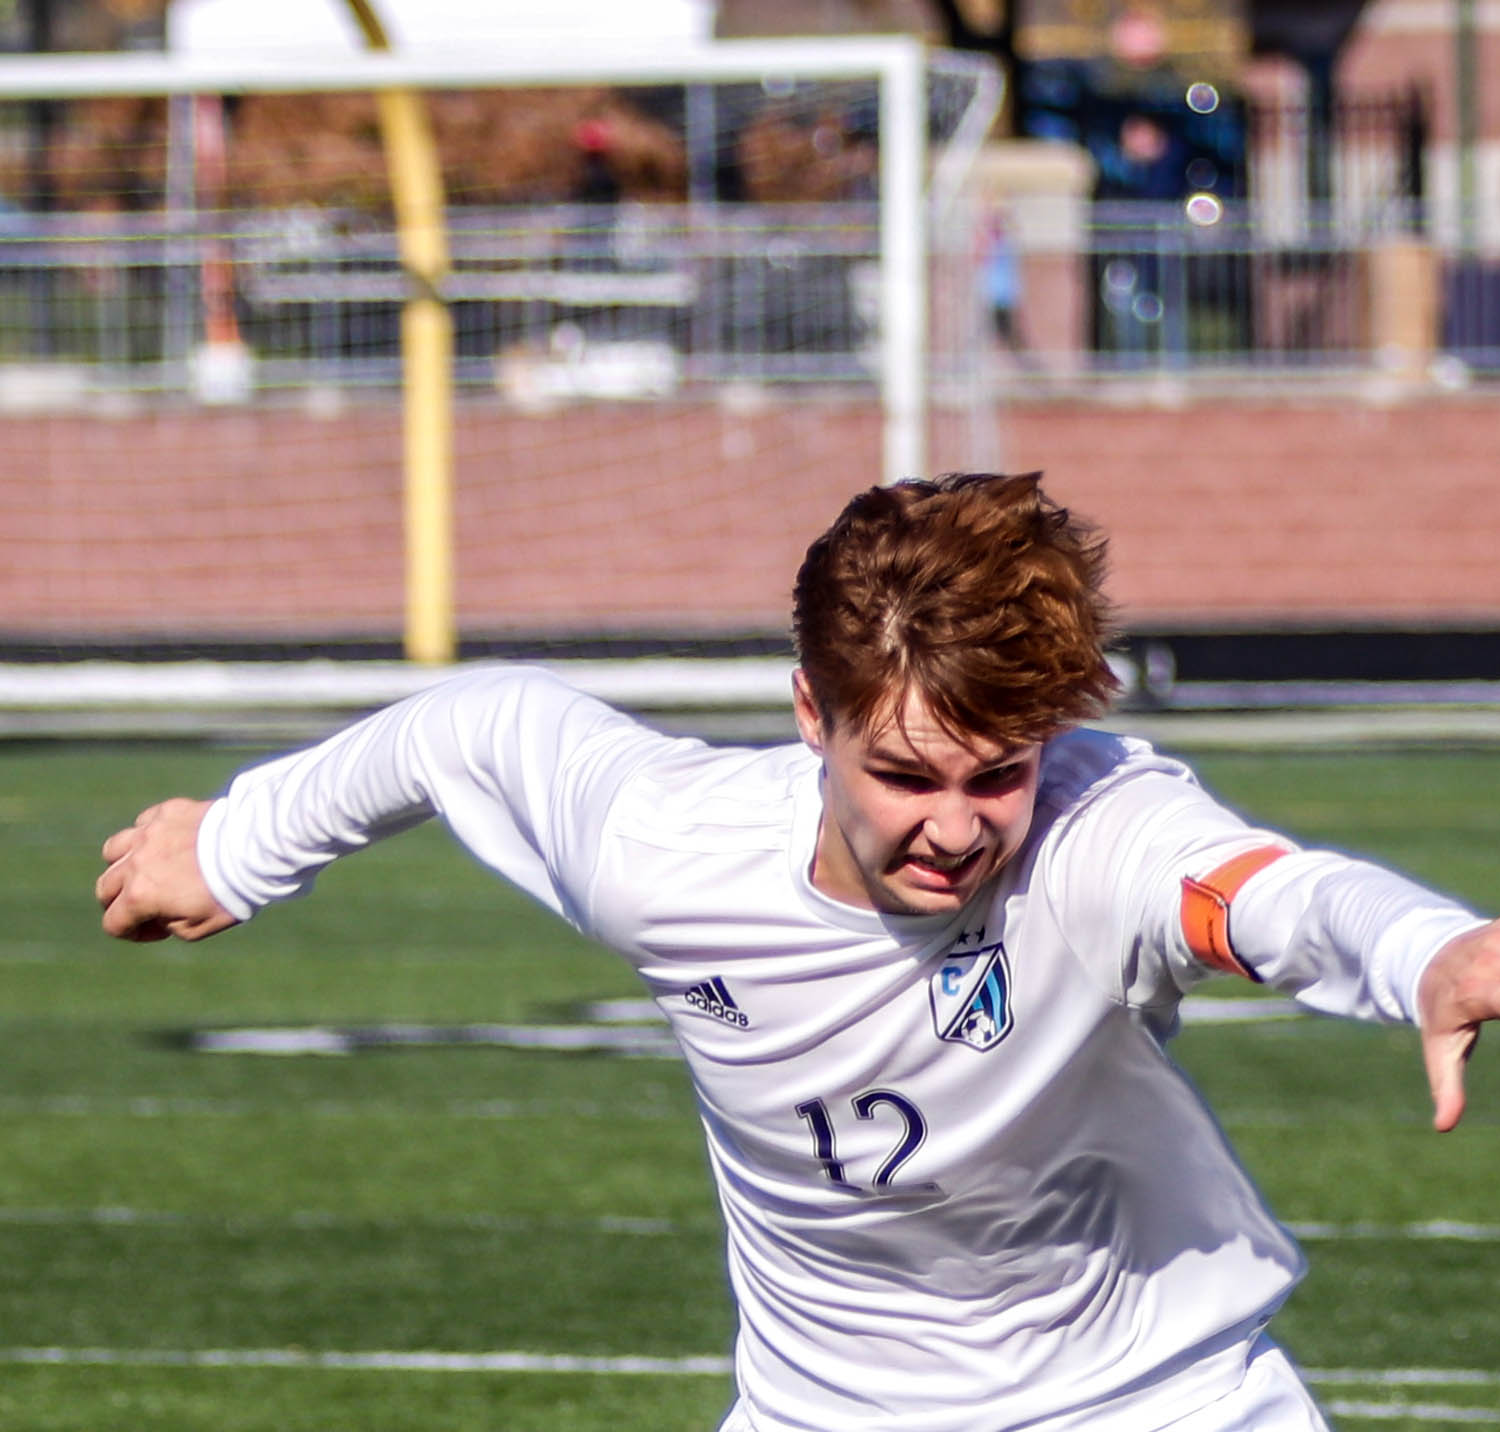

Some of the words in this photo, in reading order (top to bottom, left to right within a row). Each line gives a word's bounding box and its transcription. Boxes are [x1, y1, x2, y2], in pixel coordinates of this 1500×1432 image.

[941, 966, 962, 997] C
[684, 991, 749, 1028] adidas
[794, 1088, 946, 1197] 12
